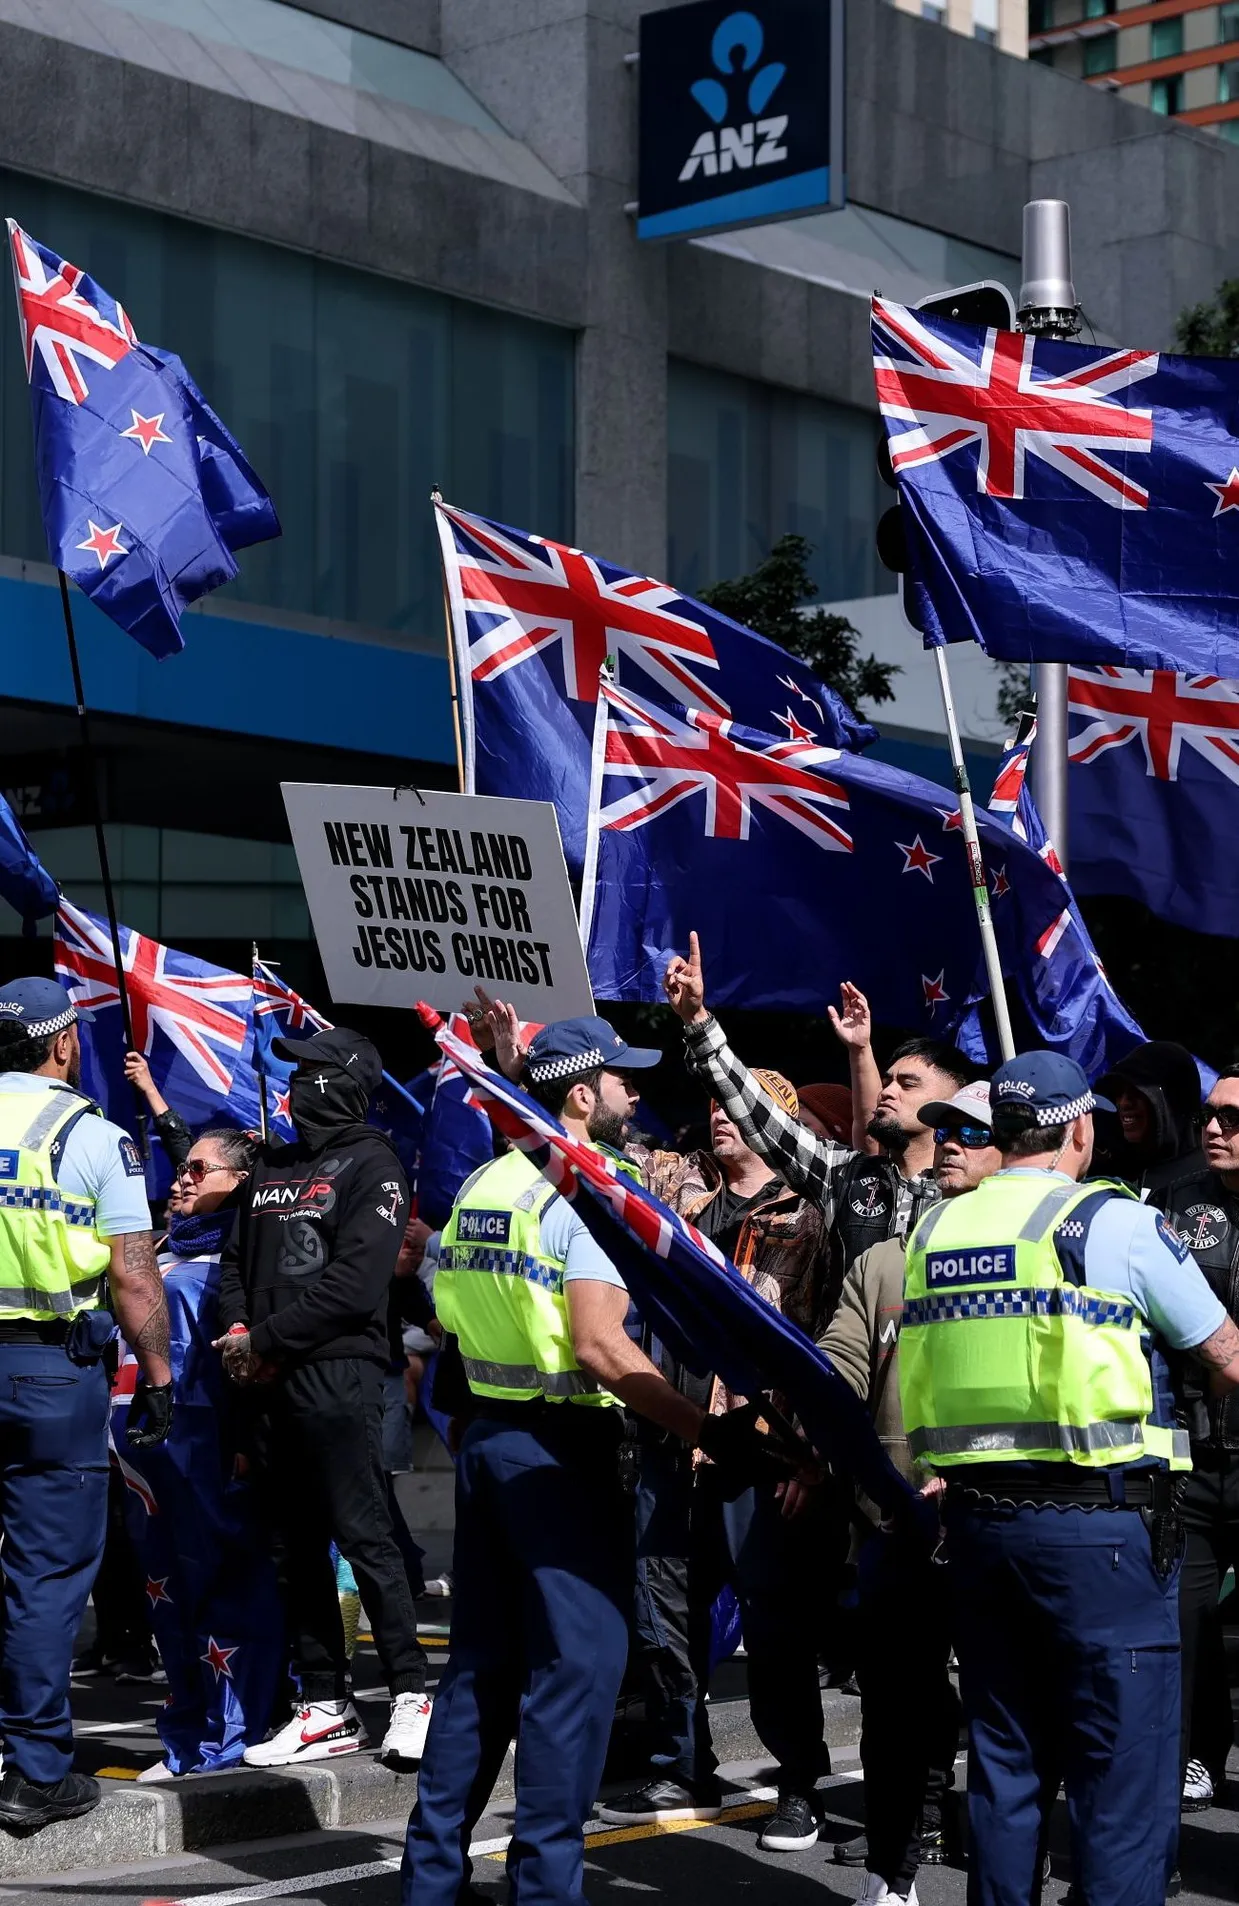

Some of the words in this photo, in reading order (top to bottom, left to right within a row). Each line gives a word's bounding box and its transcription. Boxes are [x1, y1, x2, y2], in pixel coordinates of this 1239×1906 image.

[677, 114, 789, 182] ANZ
[5, 786, 42, 816] NZ
[323, 821, 394, 868] NEW
[399, 825, 533, 881] ZEALAND
[350, 874, 468, 926] STANDS
[472, 883, 533, 933] FOR
[352, 925, 446, 974] JESUS
[452, 932, 553, 986] CHRIST
[998, 1080, 1035, 1096] POLICE
[459, 1215, 505, 1235] POLICE
[931, 1254, 1007, 1280] POLICE
